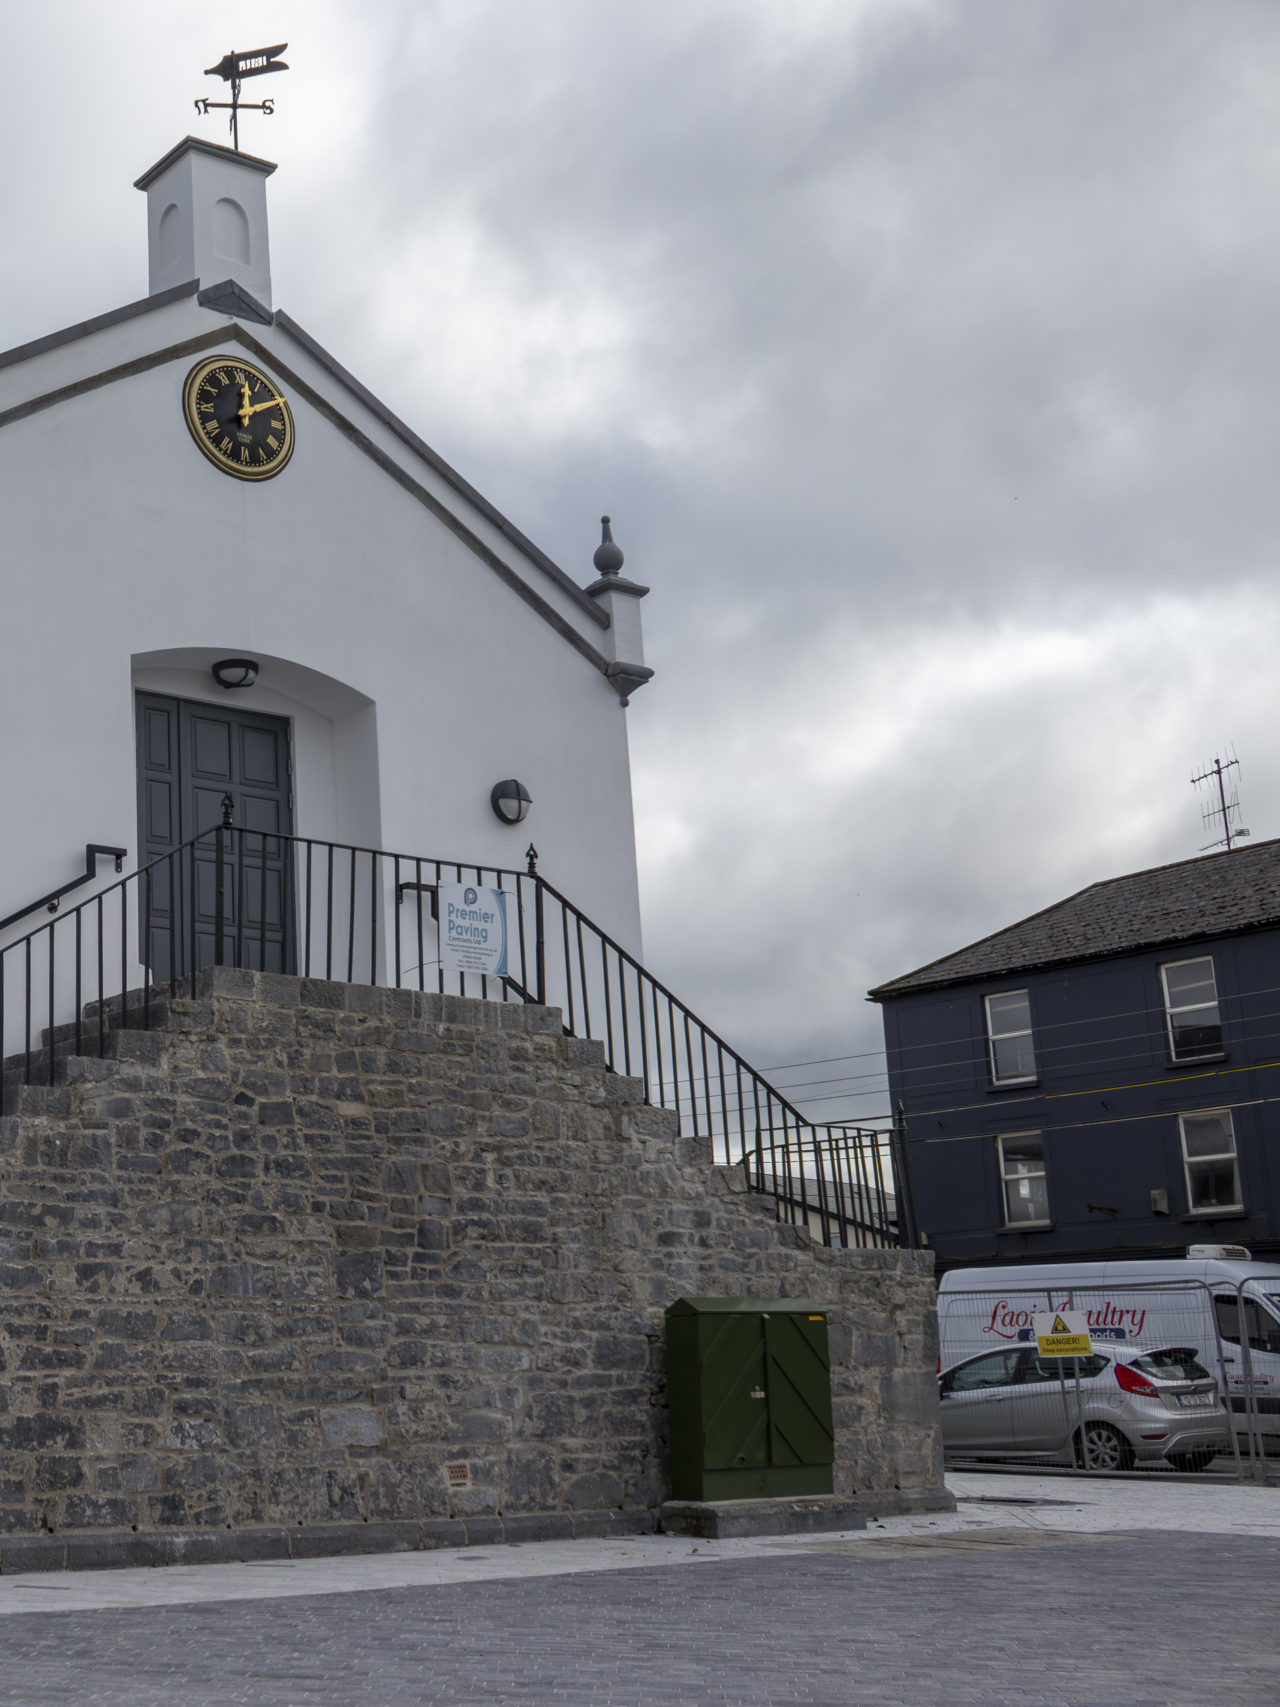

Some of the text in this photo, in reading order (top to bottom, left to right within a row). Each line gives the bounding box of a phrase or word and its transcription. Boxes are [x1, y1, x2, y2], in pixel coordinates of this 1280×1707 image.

[261, 98, 275, 115] S
[447, 902, 495, 924] Premier
[448, 919, 488, 943] Paving
[1046, 1337, 1081, 1346] DANGER!
